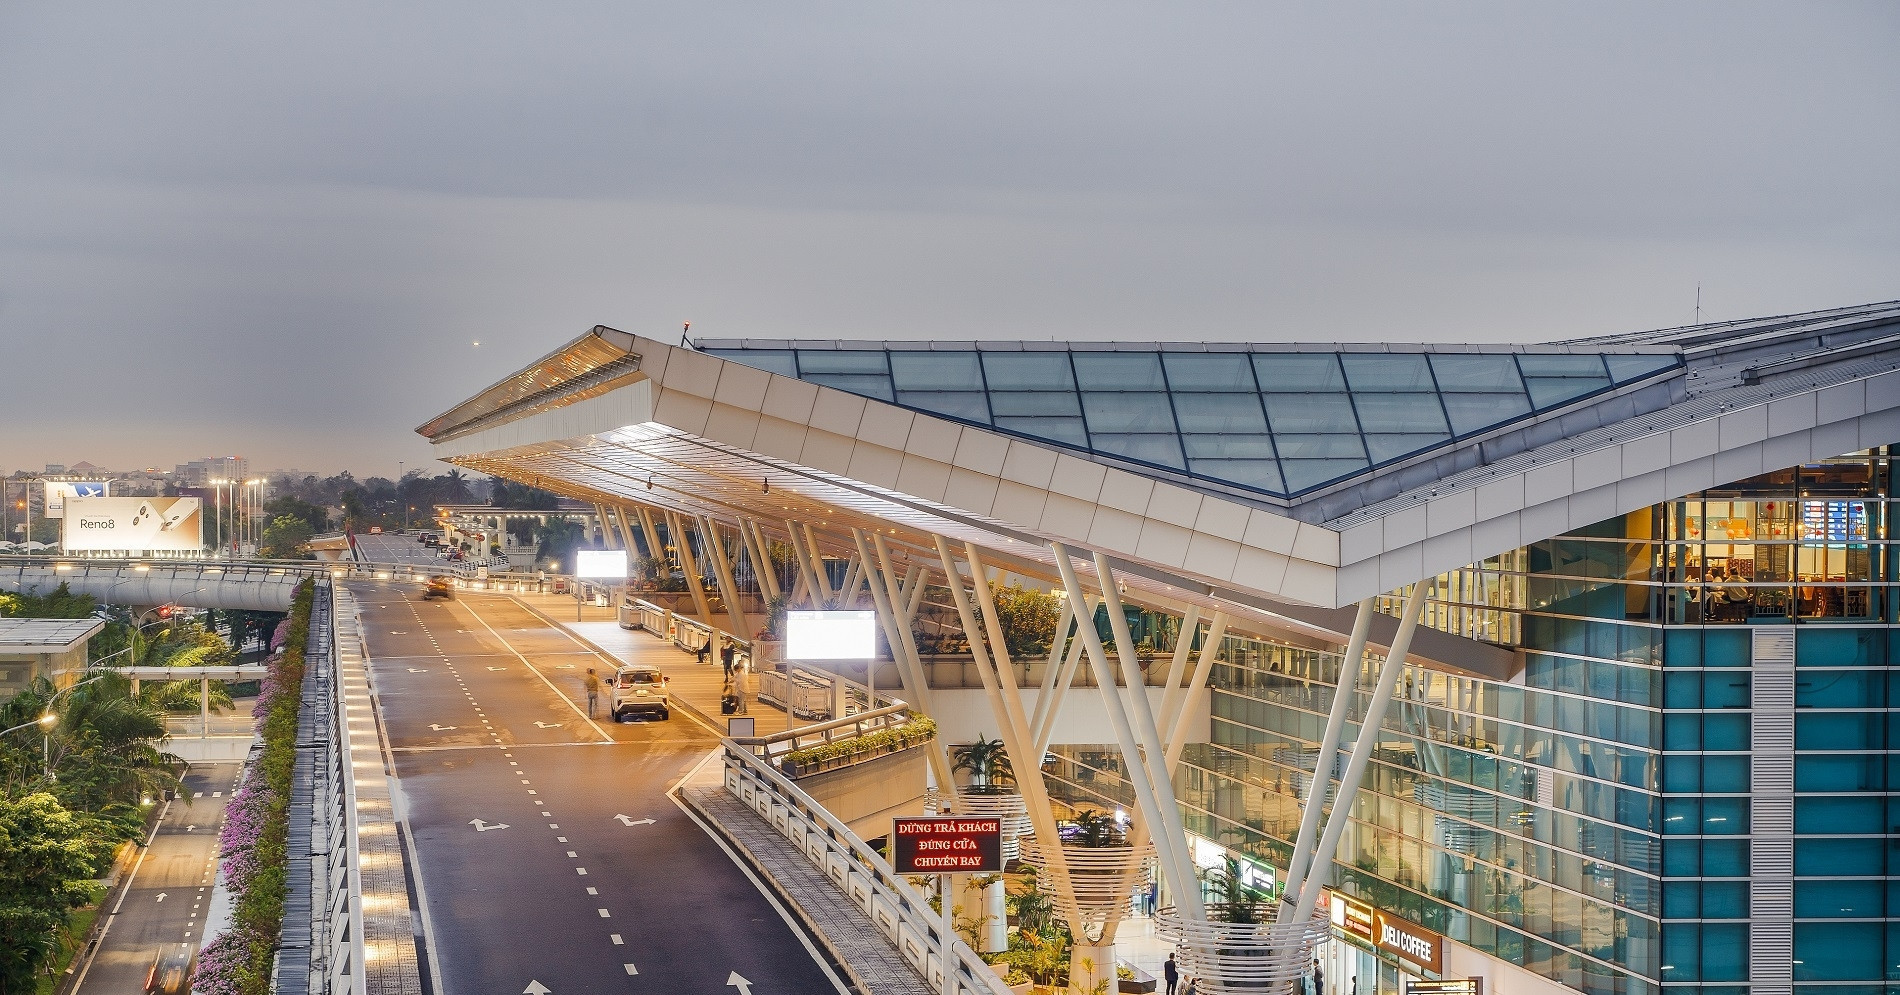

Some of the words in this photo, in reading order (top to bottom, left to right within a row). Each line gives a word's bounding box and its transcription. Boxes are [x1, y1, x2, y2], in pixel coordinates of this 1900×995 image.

[80, 519, 115, 529] Reno8
[898, 823, 931, 833] DỪNG
[934, 821, 956, 832] TRẢ
[958, 822, 997, 832] KHÁCH
[919, 839, 951, 850] ĐÚNG
[953, 838, 977, 849] CỬA
[960, 857, 981, 866] BAY
[1383, 924, 1400, 948] DELI
[1401, 932, 1432, 962] COFFEE
